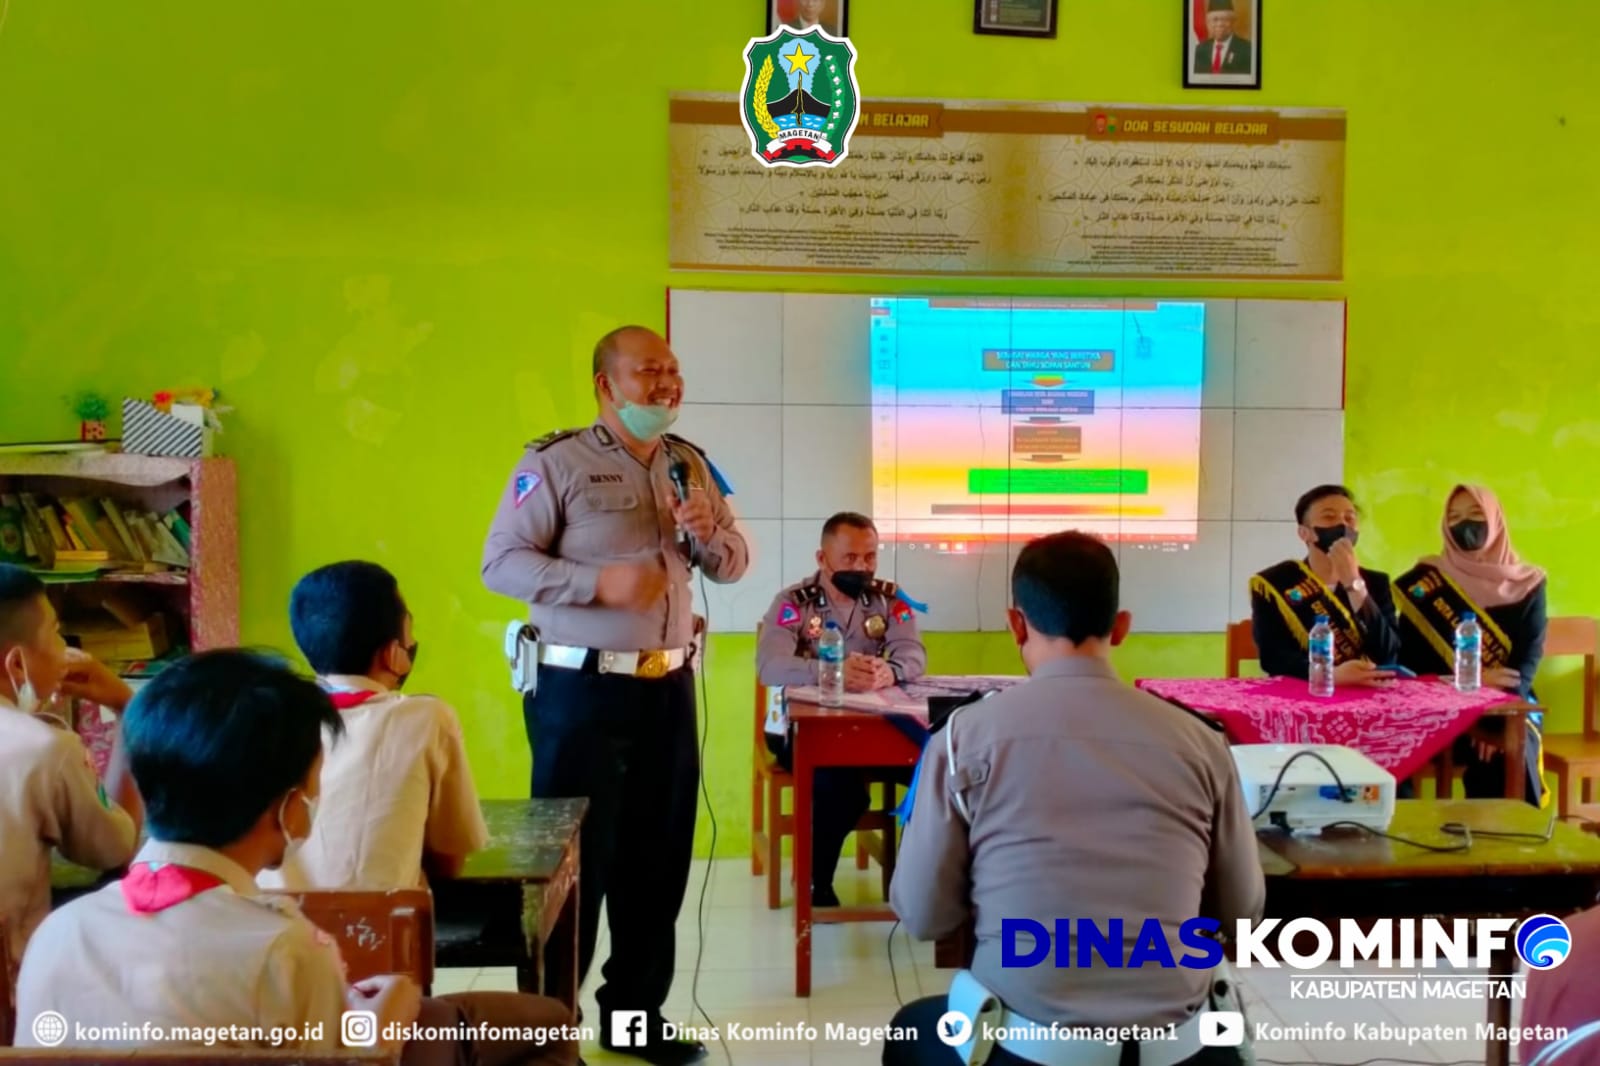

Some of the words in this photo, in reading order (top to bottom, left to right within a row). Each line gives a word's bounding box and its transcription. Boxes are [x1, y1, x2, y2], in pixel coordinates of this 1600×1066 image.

[873, 113, 929, 128] BELAJAR
[1123, 119, 1149, 132] DOA
[1153, 120, 1210, 134] SESUDAH
[1214, 121, 1268, 136] BELAJAR
[590, 473, 623, 484] BENNY
